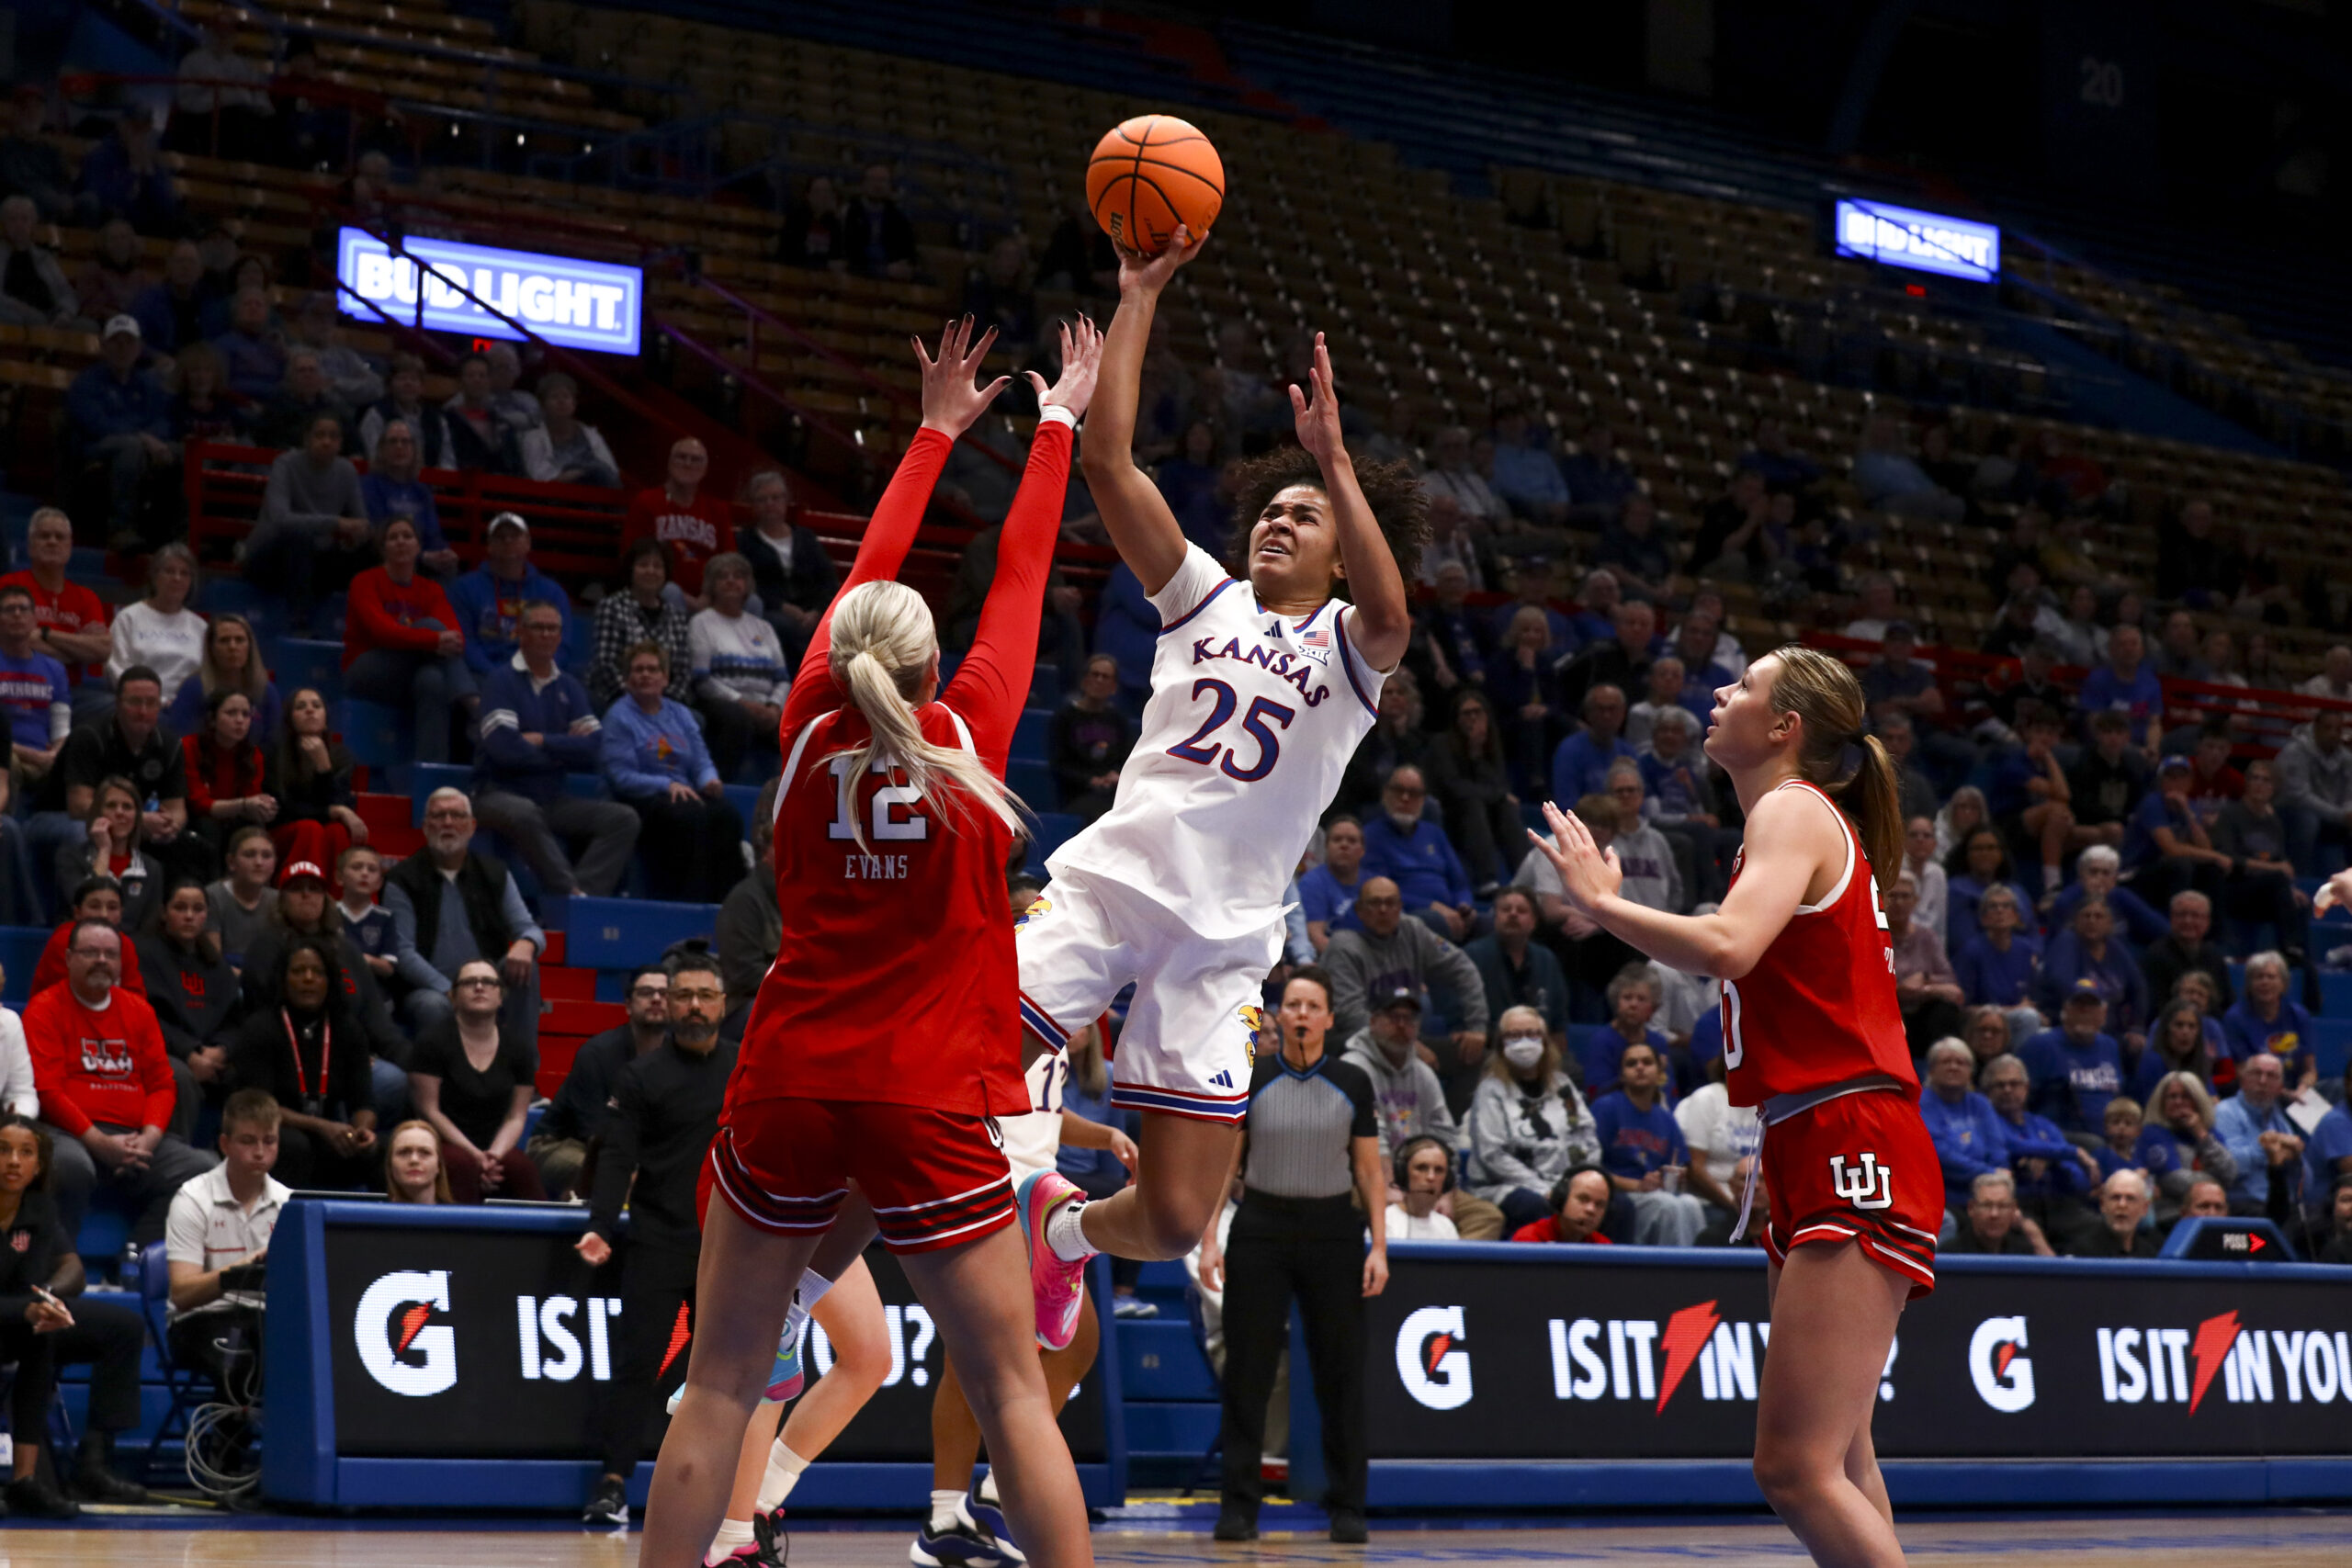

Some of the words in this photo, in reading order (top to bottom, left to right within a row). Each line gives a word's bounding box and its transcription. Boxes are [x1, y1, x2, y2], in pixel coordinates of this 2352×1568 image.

[2080, 57, 2122, 107] 20
[356, 252, 469, 310] BUD
[473, 267, 625, 331] LIGHT
[1193, 637, 1329, 707] KANSAS
[1166, 678, 1295, 782] 25
[829, 752, 926, 840] 12
[844, 854, 908, 879] EVANS
[354, 1269, 458, 1396] G
[1396, 1305, 1474, 1411] G
[1969, 1315, 2037, 1413] G
